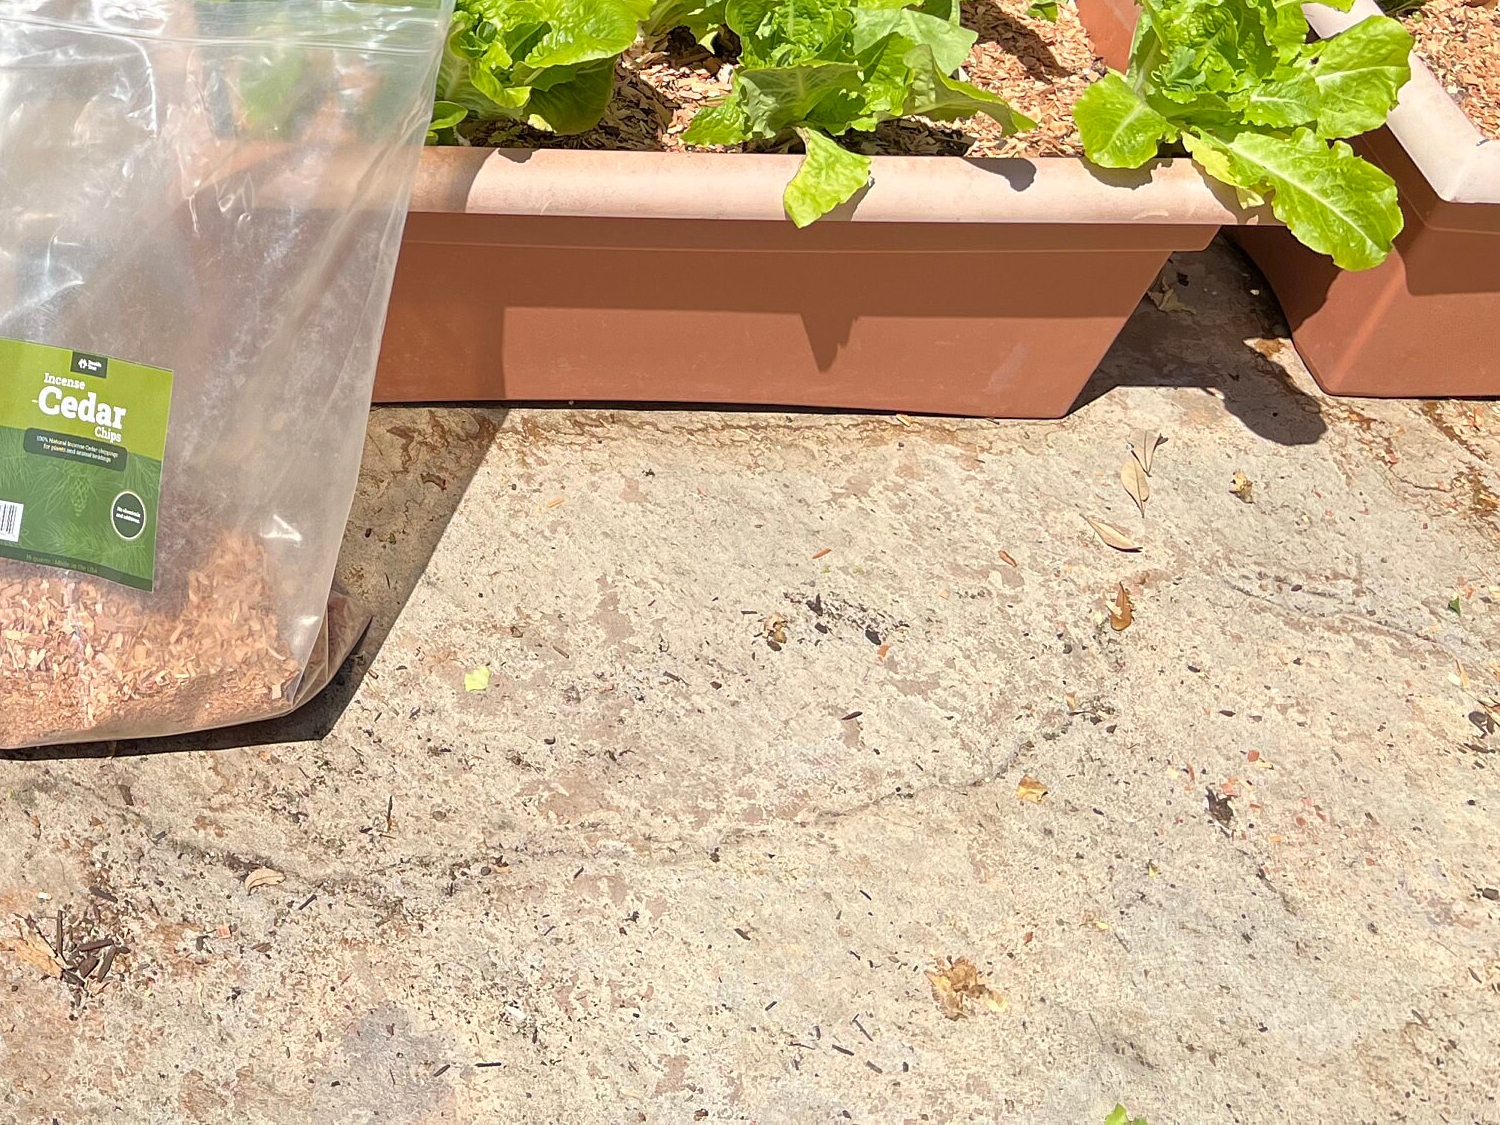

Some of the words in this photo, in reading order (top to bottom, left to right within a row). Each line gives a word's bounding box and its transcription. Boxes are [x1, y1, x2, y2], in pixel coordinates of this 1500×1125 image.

[43, 372, 86, 390] Incense
[38, 385, 127, 429] Cedar
[49, 437, 67, 446] Natural
[94, 426, 122, 443] Chips
